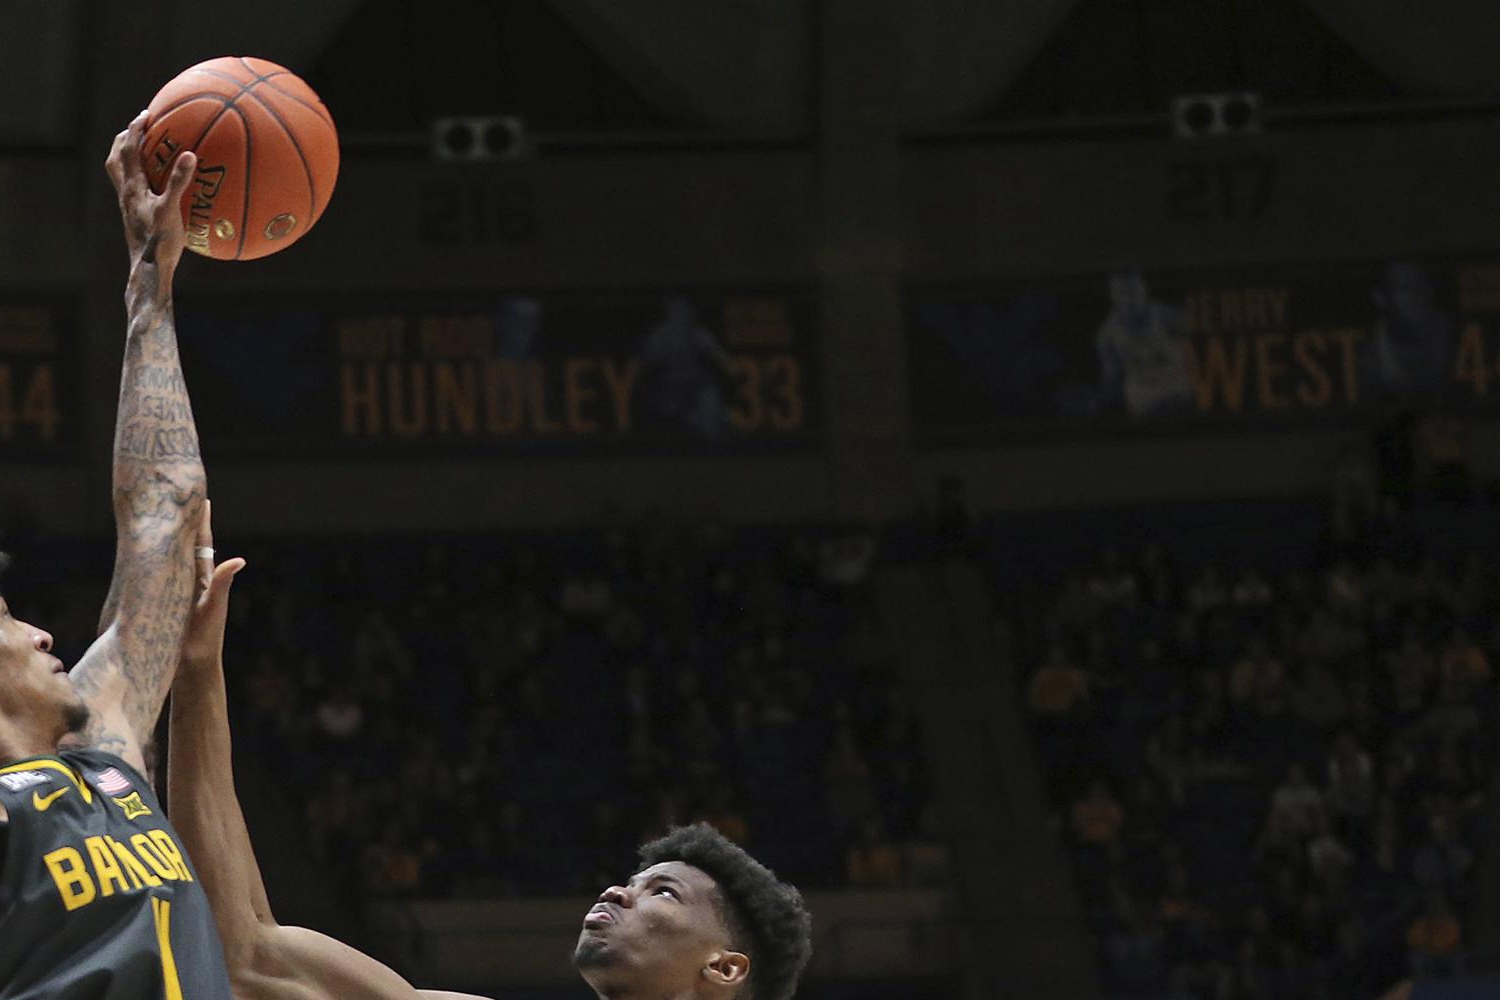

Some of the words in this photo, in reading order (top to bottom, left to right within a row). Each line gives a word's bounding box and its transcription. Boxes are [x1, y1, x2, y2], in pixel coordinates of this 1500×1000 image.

[419, 180, 537, 243] 216
[1165, 155, 1277, 221] 217
[341, 355, 642, 435] HUNDLEY
[726, 352, 804, 433] 33
[1180, 328, 1367, 411] WEST
[1453, 321, 1500, 395] 4
